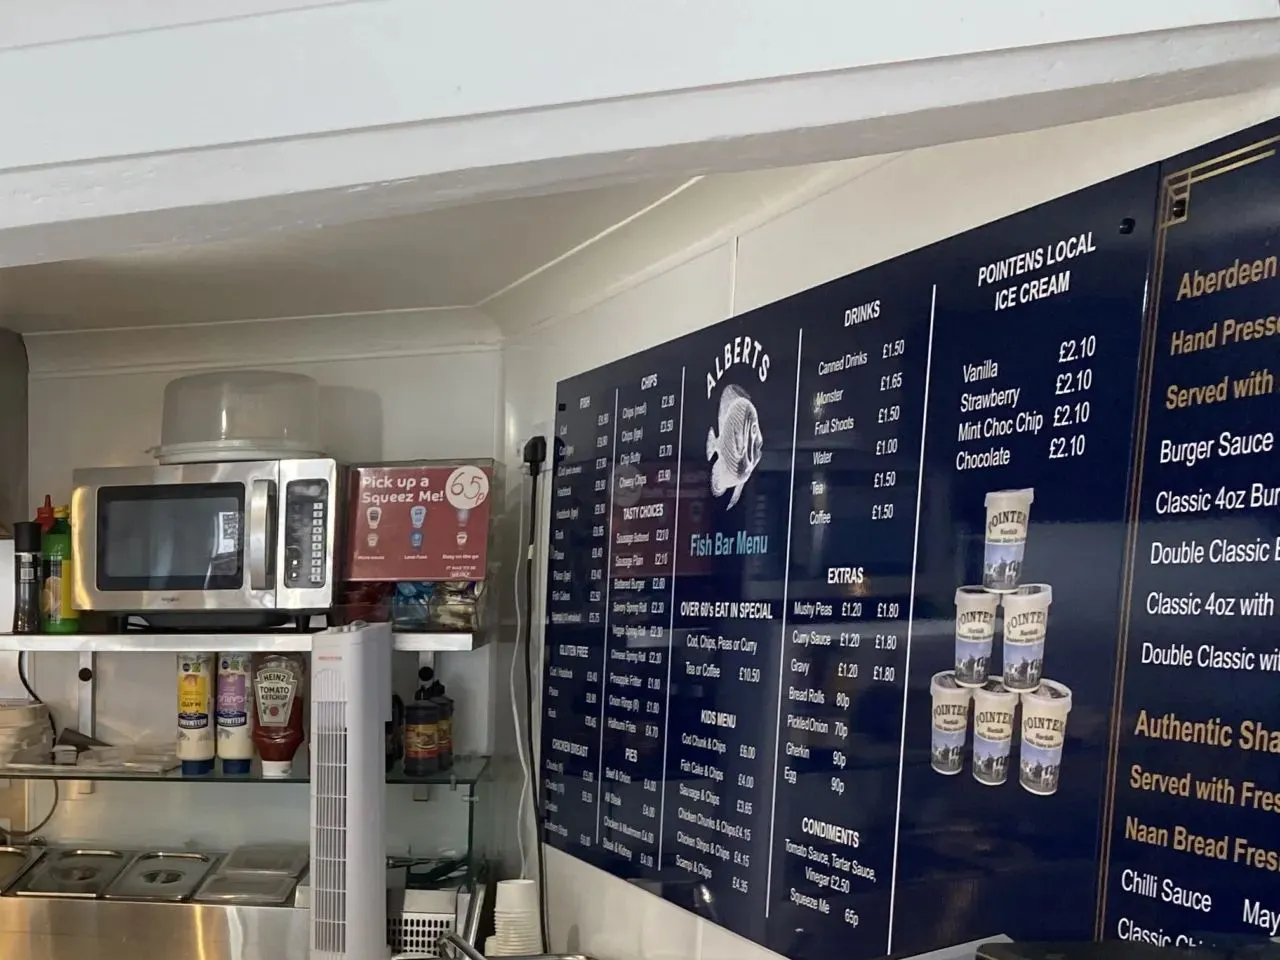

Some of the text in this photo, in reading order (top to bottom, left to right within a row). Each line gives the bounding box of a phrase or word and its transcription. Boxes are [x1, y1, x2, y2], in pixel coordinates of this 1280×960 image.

[978, 232, 1096, 287] POINTENS LOCAL
[995, 271, 1070, 310] ICE CREAM
[1177, 256, 1278, 301] Aberdeen
[844, 300, 880, 327] DRINKS
[1171, 315, 1280, 355] Hand Press
[707, 336, 770, 399] ALBERTS
[818, 340, 904, 376] Canned Drinks £1.50
[963, 336, 1096, 383] Vanilla £2.10
[817, 373, 902, 406] Monster £1.65
[960, 369, 1092, 412] Strawberry £2.10
[1166, 371, 1273, 409] Served with
[815, 406, 900, 435] Fruit Shoots £1.50
[958, 402, 1090, 442] Mint Choc Chip £2.10
[813, 439, 897, 465] Water £1.00
[956, 434, 1085, 470] Chocolate £2.10
[1160, 432, 1273, 466] Burger Sauce
[362, 476, 429, 490] Pick up a
[812, 471, 896, 494] Tea £1.50
[362, 490, 444, 505] Squeez Me!
[1156, 489, 1211, 514] Classic
[1215, 486, 1245, 510] 4oz
[623, 503, 663, 520] TASTY CHOICES
[810, 504, 893, 525] Coffee £1.50
[691, 531, 768, 556] Fish Bar Menu
[1151, 538, 1270, 564] Double Classic
[827, 568, 863, 584] EXTRAS
[681, 602, 699, 616] OVER
[715, 602, 729, 618] EAT
[731, 602, 738, 618] IN
[740, 602, 772, 619] SPECIAL
[794, 602, 899, 618] Mushy Peas £1.20 £1.80
[1147, 592, 1274, 616] Classic 4oz with
[718, 637, 732, 651] Peas
[733, 640, 739, 651] or
[741, 638, 757, 655] Curry
[793, 630, 897, 650] Curry Sauce £1.20 £1.80
[1142, 642, 1193, 666] Double
[1198, 644, 1255, 670] Classic
[264, 673, 286, 682] HEINZ
[686, 662, 695, 675] Tea
[703, 664, 720, 677] Coffee
[739, 667, 760, 682] £10.50
[791, 659, 895, 682] Gravy £1.20 £1.80
[261, 686, 289, 694] TOMATO
[789, 687, 850, 710] Bread Rolls 80p
[701, 709, 736, 728] KIDS MENU
[788, 715, 848, 739] Pickled Onion 70p
[1134, 710, 1233, 747] Authentic
[786, 742, 846, 769] Gherkin 90p
[784, 767, 844, 795] Egg 90p
[1130, 765, 1191, 796] Served
[1196, 777, 1234, 804] with
[802, 817, 859, 847] CONDIMENTS
[1125, 816, 1280, 872] Naan Bread Fres
[785, 839, 807, 859] Tomato
[832, 854, 851, 873] Tartar
[806, 867, 850, 894] Vinegar £2.50
[1122, 869, 1157, 898] Chilli
[1162, 879, 1212, 912] Sauce
[790, 888, 858, 928] Squeeze Me 65p
